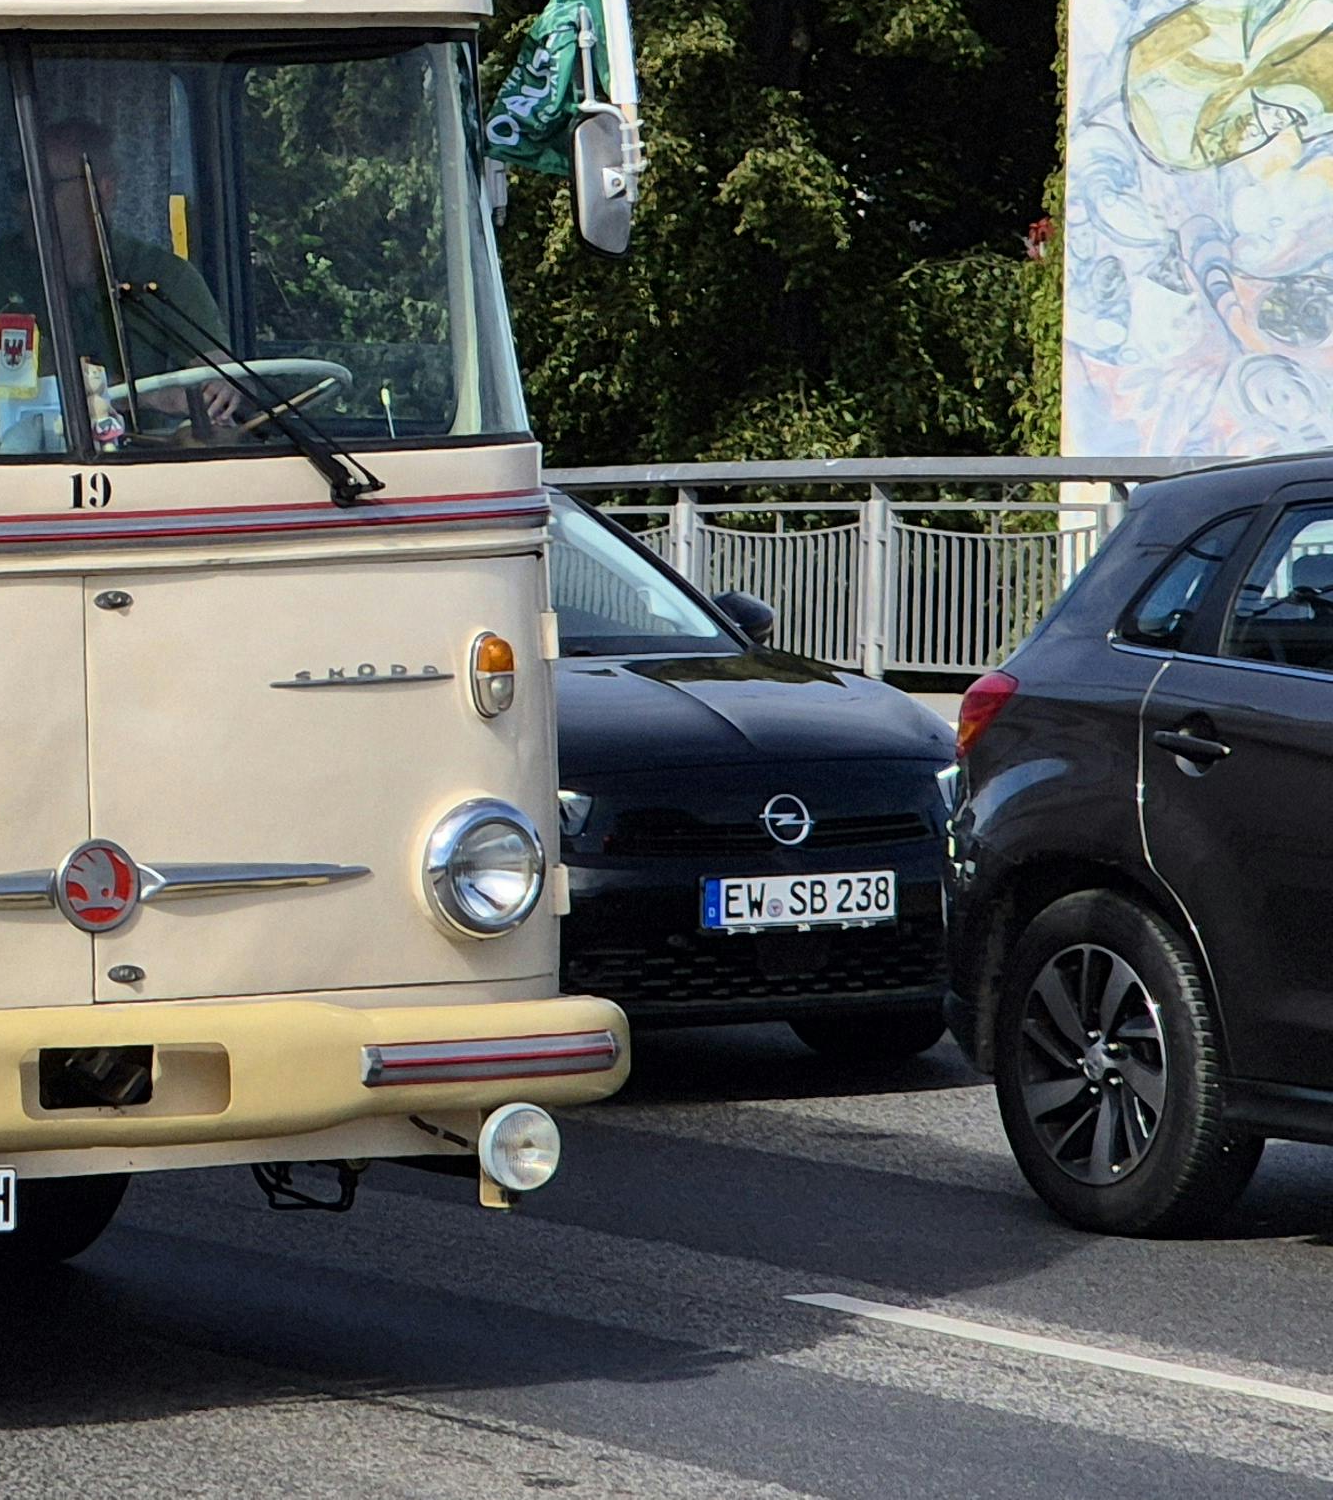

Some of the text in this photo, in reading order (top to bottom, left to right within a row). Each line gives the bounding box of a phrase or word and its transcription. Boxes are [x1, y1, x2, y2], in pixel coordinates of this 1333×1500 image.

[69, 472, 112, 509] 19
[725, 883, 765, 919] EW
[789, 880, 827, 916] SB
[836, 876, 890, 913] 238
